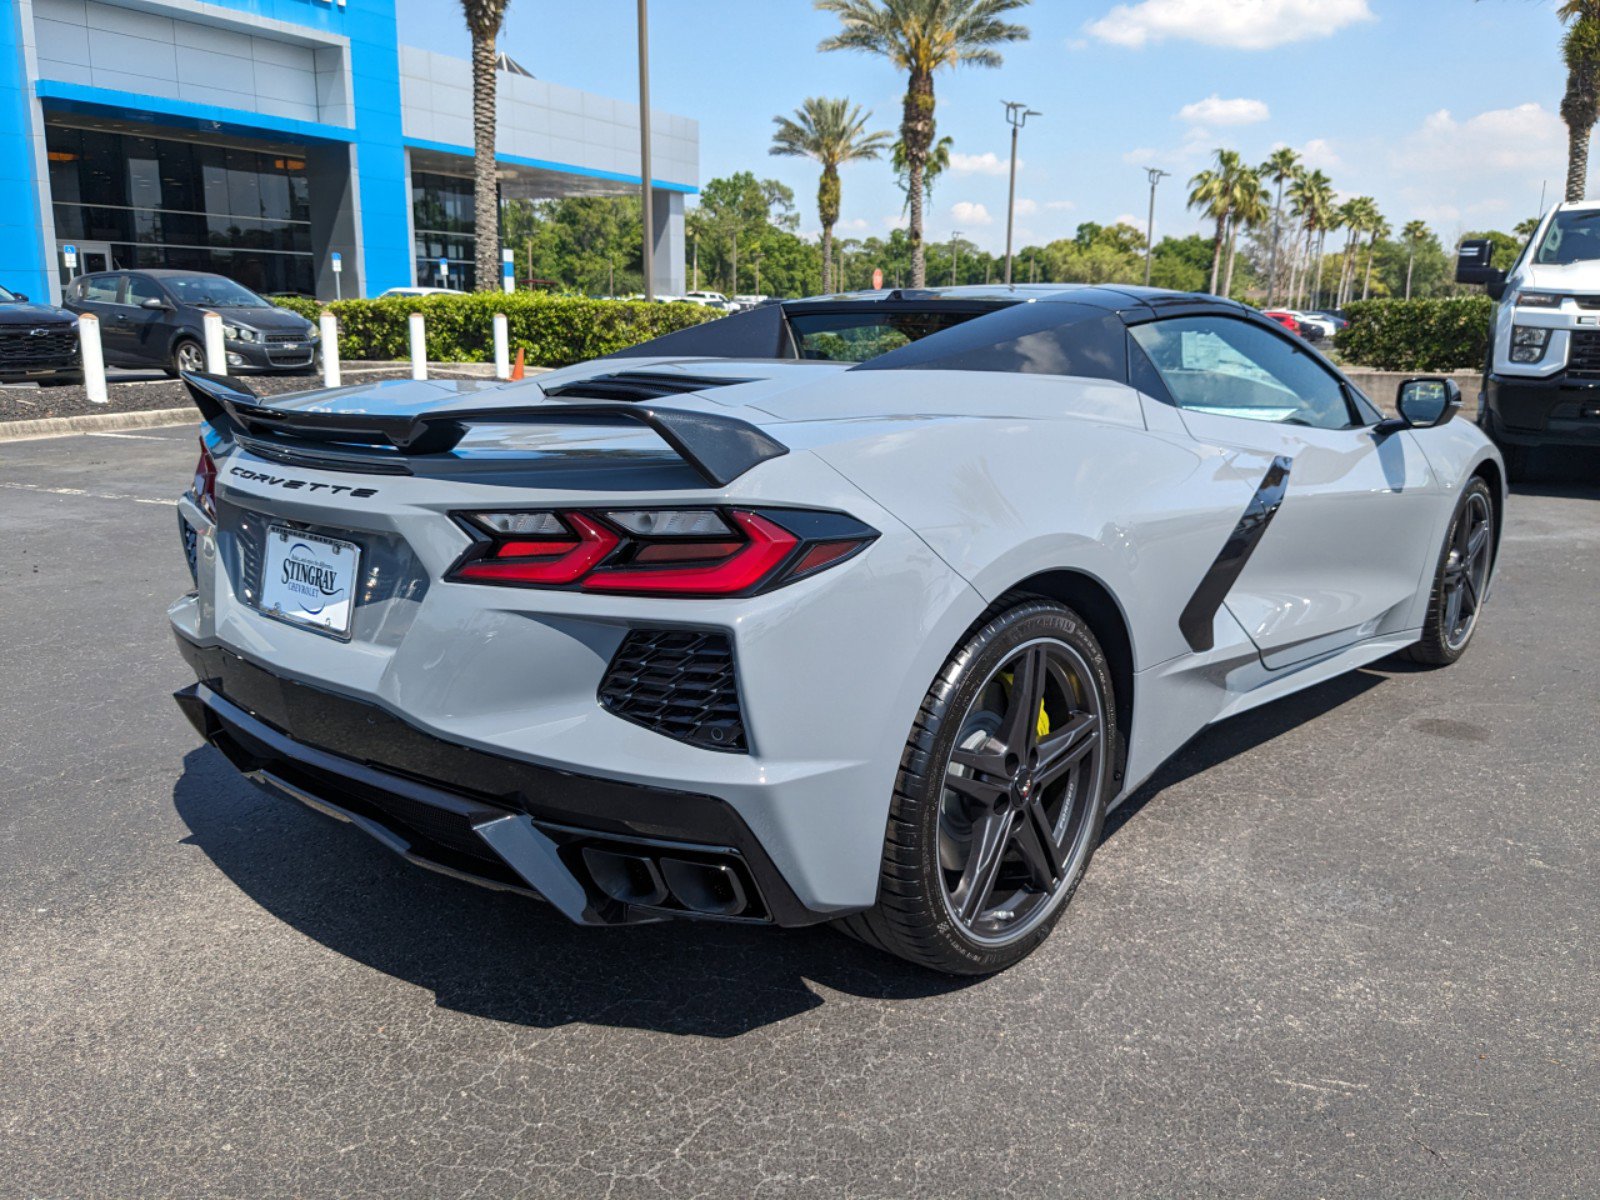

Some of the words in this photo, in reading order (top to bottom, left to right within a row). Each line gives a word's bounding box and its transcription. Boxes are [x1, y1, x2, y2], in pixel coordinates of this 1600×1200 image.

[229, 466, 379, 498] CORVETTE
[281, 558, 341, 595] STINGRAY
[288, 581, 319, 598] CHEVROLET
